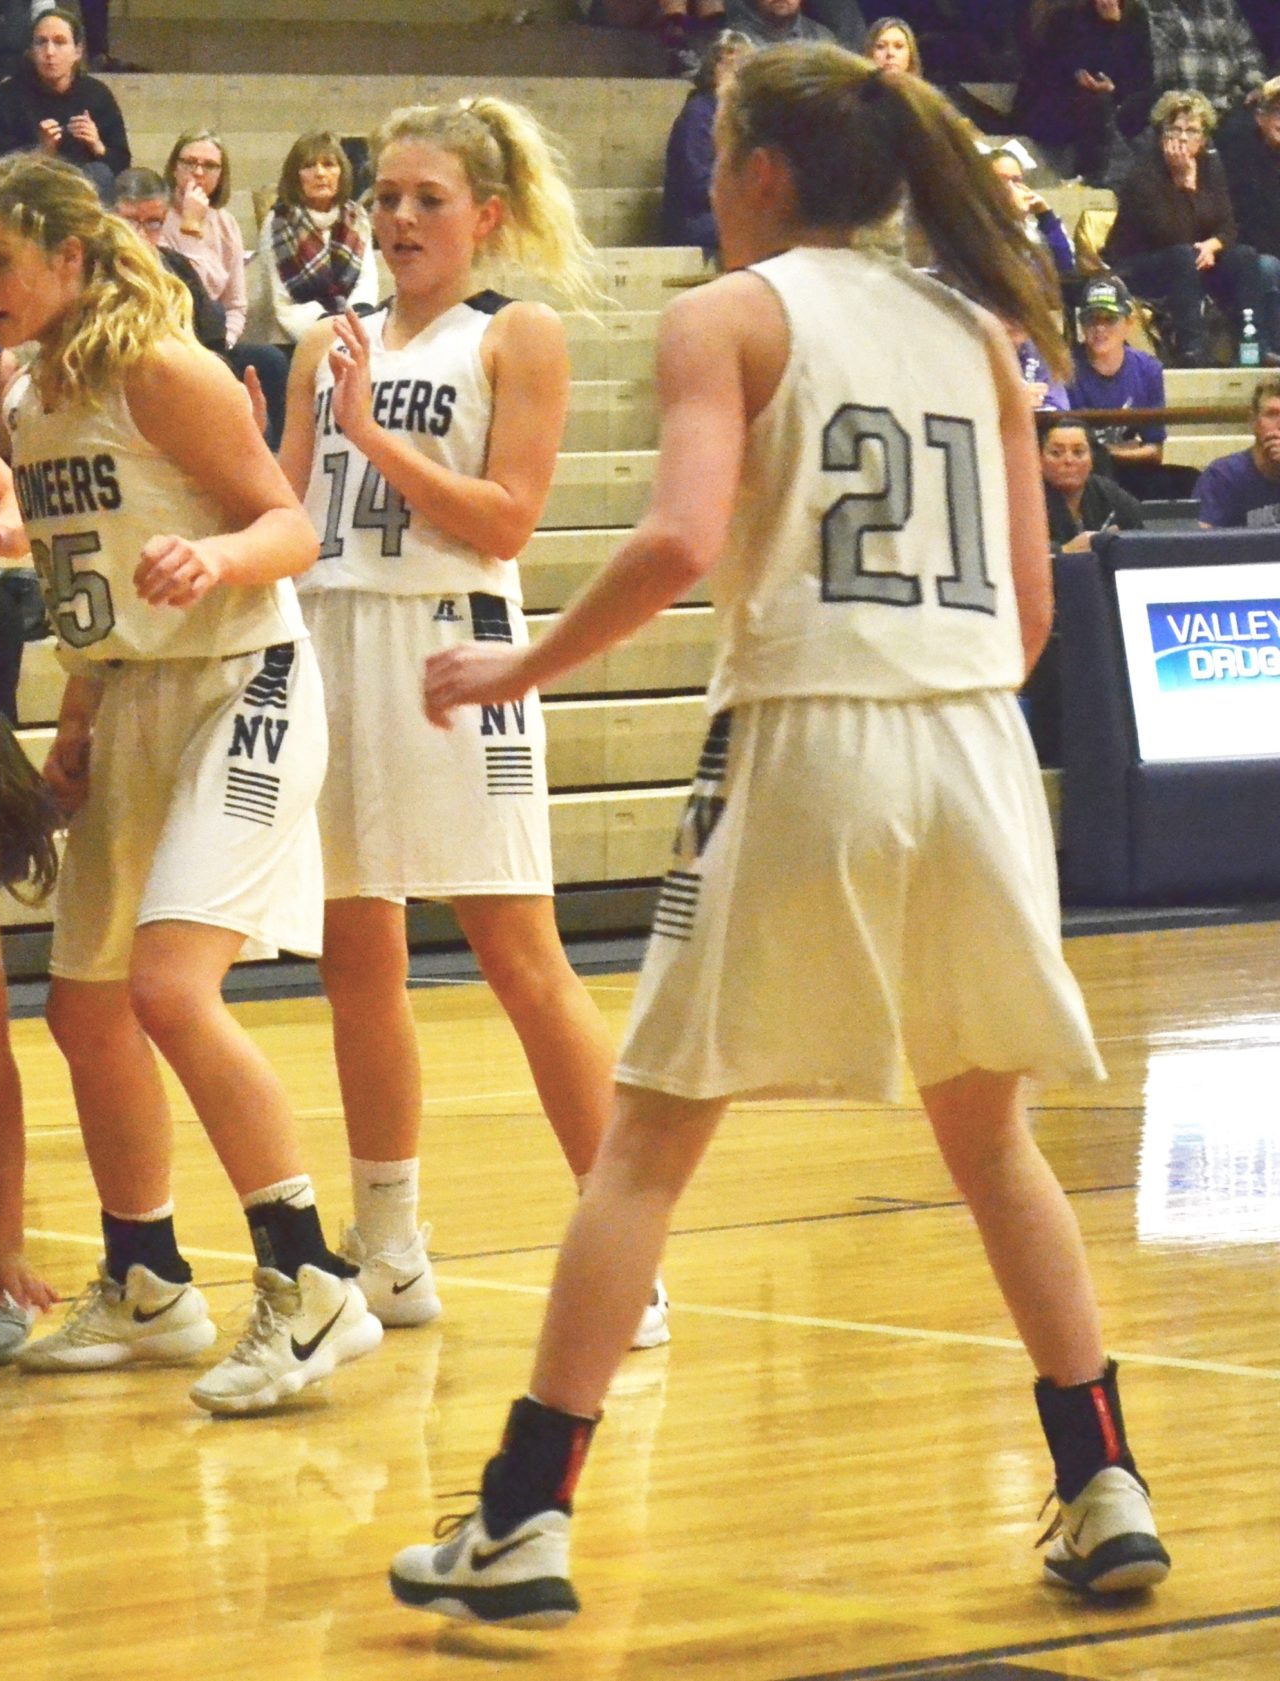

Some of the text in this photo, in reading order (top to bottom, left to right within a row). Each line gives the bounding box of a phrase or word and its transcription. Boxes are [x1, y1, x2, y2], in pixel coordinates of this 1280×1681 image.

[318, 451, 411, 559] 14
[821, 402, 998, 617] 21
[1166, 610, 1280, 643] VALLEY
[1187, 646, 1280, 680] DRUG
[228, 713, 289, 765] NV
[480, 697, 526, 736] NV
